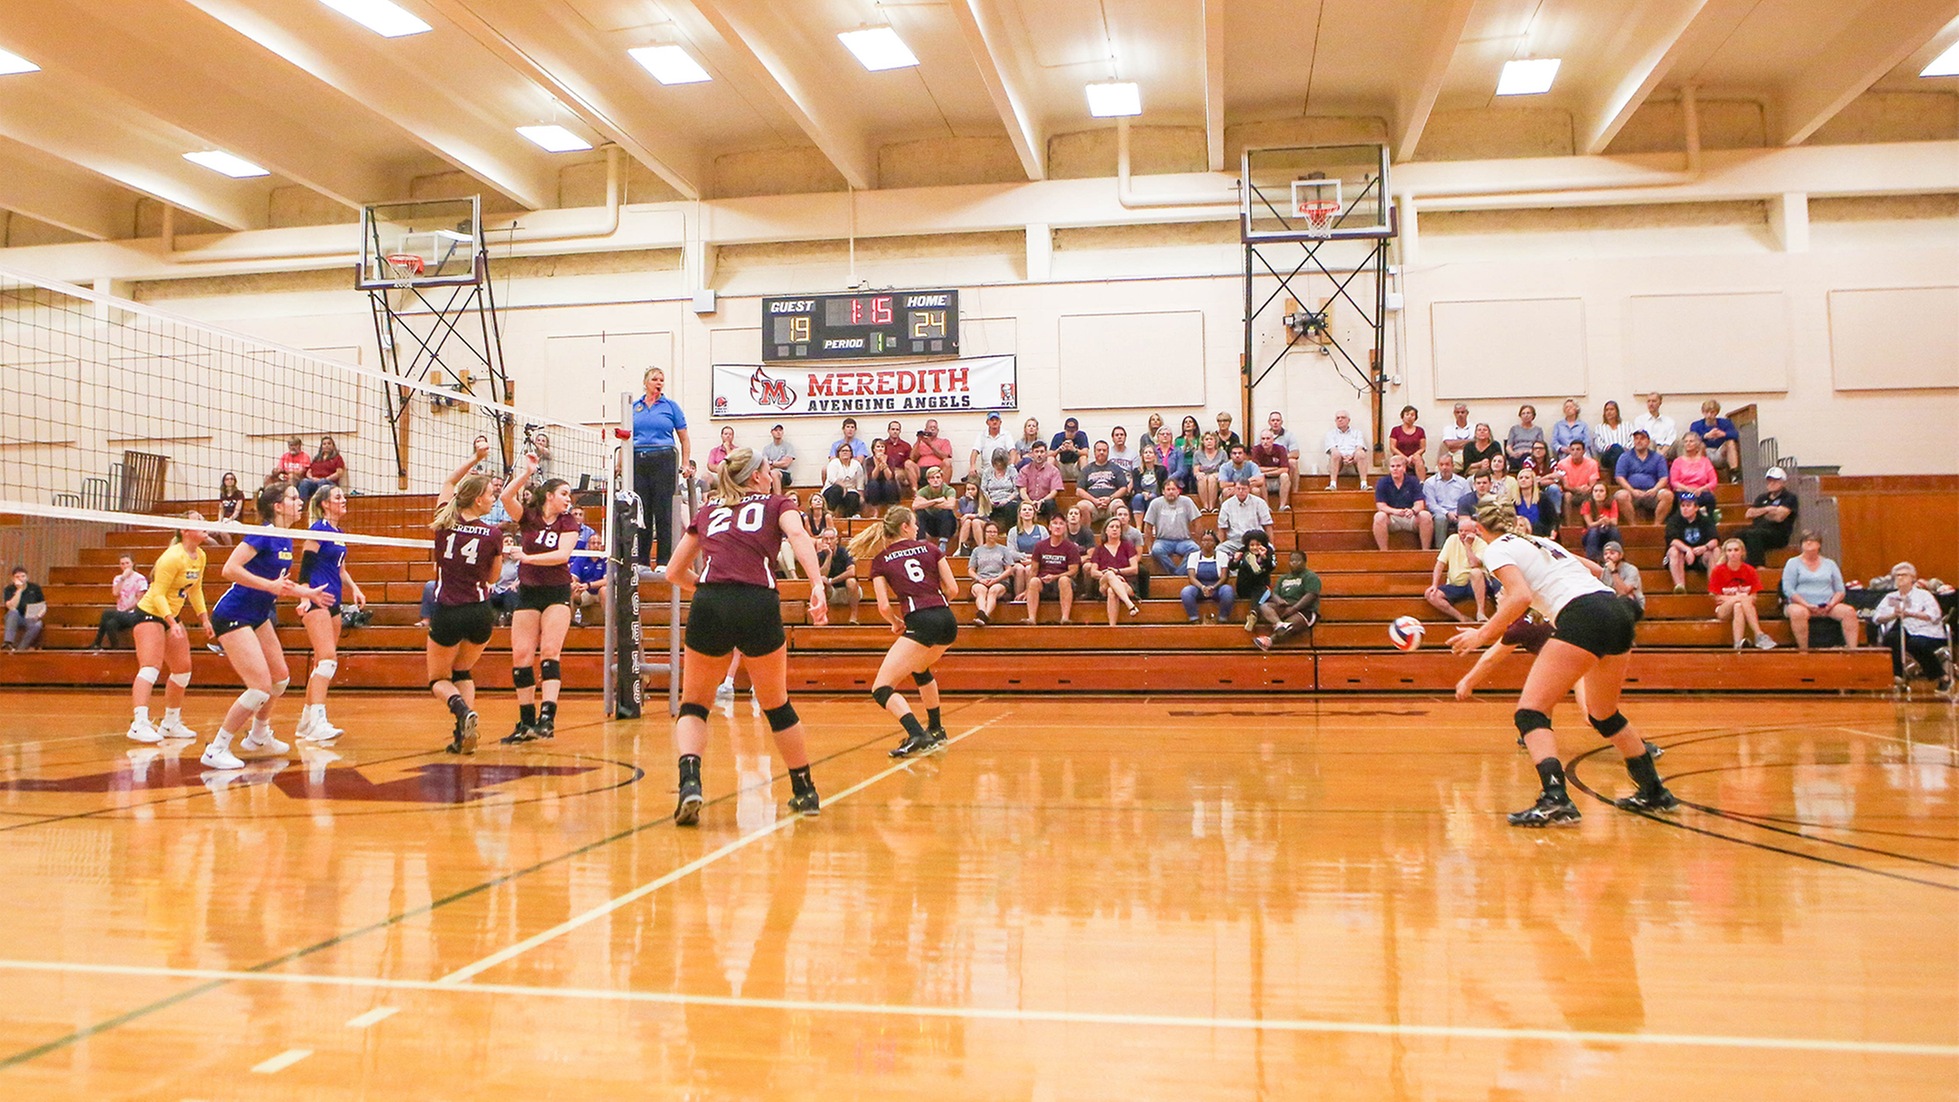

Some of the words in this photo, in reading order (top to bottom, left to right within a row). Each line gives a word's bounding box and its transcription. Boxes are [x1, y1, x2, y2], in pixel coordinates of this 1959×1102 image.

[770, 301, 814, 312] GUEST
[850, 296, 893, 324] 1:15
[907, 295, 947, 307] HOME
[790, 316, 811, 343] 19
[913, 311, 947, 338] 24
[824, 338, 864, 350] PERIOD
[758, 379, 791, 406] M
[807, 368, 970, 397] MEREDITH
[807, 398, 895, 413] AVENGING
[903, 395, 971, 409] ANGELS
[449, 524, 490, 536] EREDITH
[706, 502, 764, 537] 20
[443, 532, 480, 565] 14
[535, 530, 558, 548] 18
[884, 545, 928, 563] MEREDITH
[904, 558, 925, 583] 6
